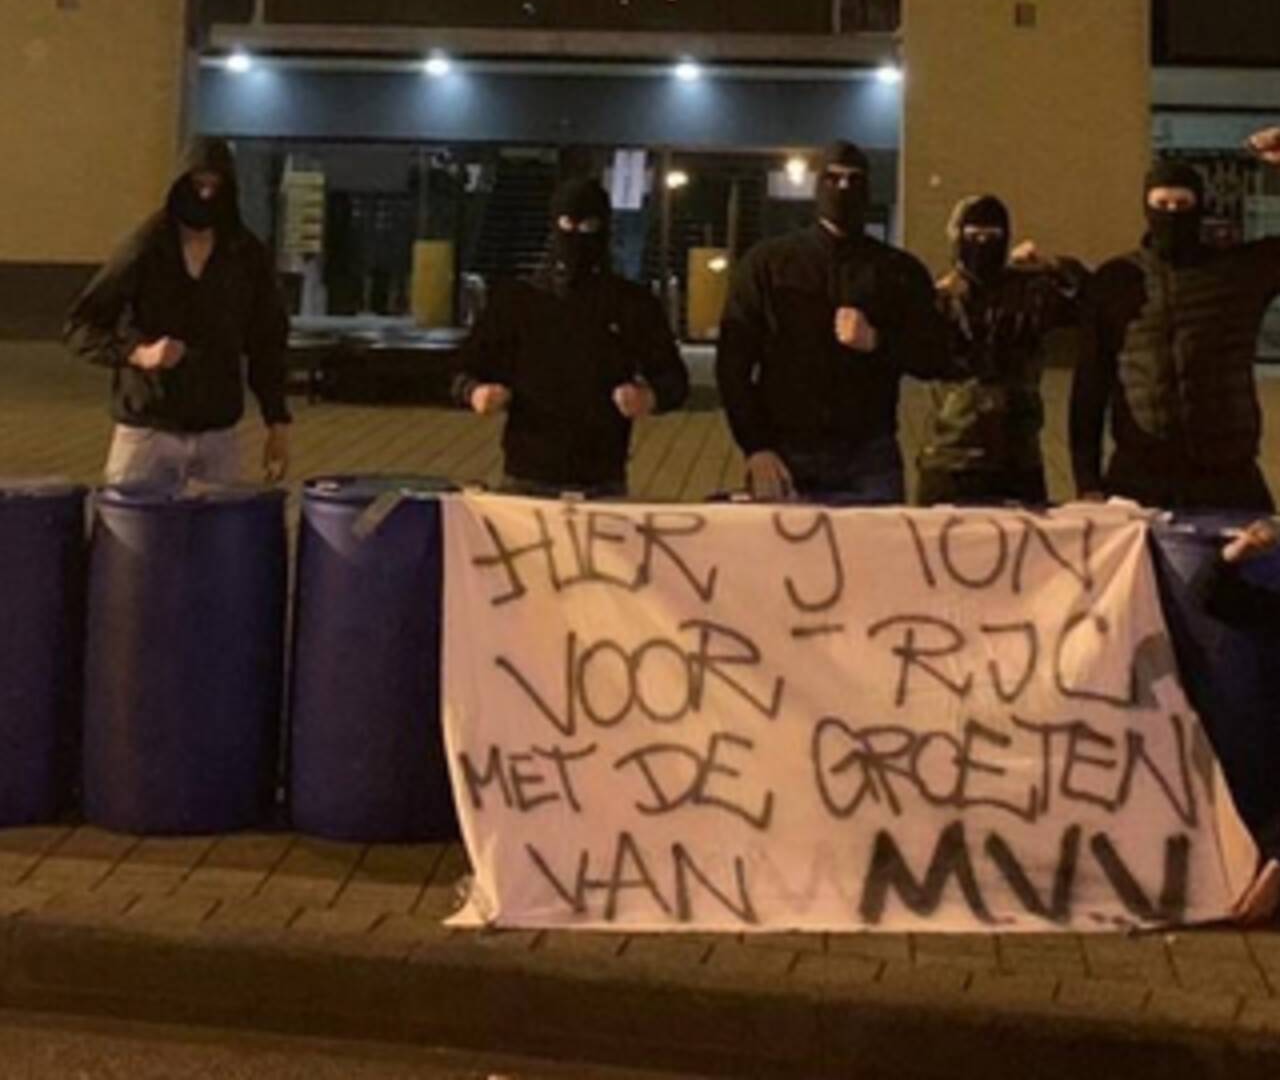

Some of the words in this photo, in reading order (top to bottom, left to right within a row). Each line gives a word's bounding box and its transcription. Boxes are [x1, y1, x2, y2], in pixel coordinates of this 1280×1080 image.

[472, 506, 718, 607] HIER
[494, 618, 786, 737] VOOR
[459, 744, 598, 813] MET
[613, 732, 775, 831] DE
[811, 715, 1200, 828] GROETEN
[524, 830, 762, 925] VAN
[859, 821, 1191, 926] MVV
